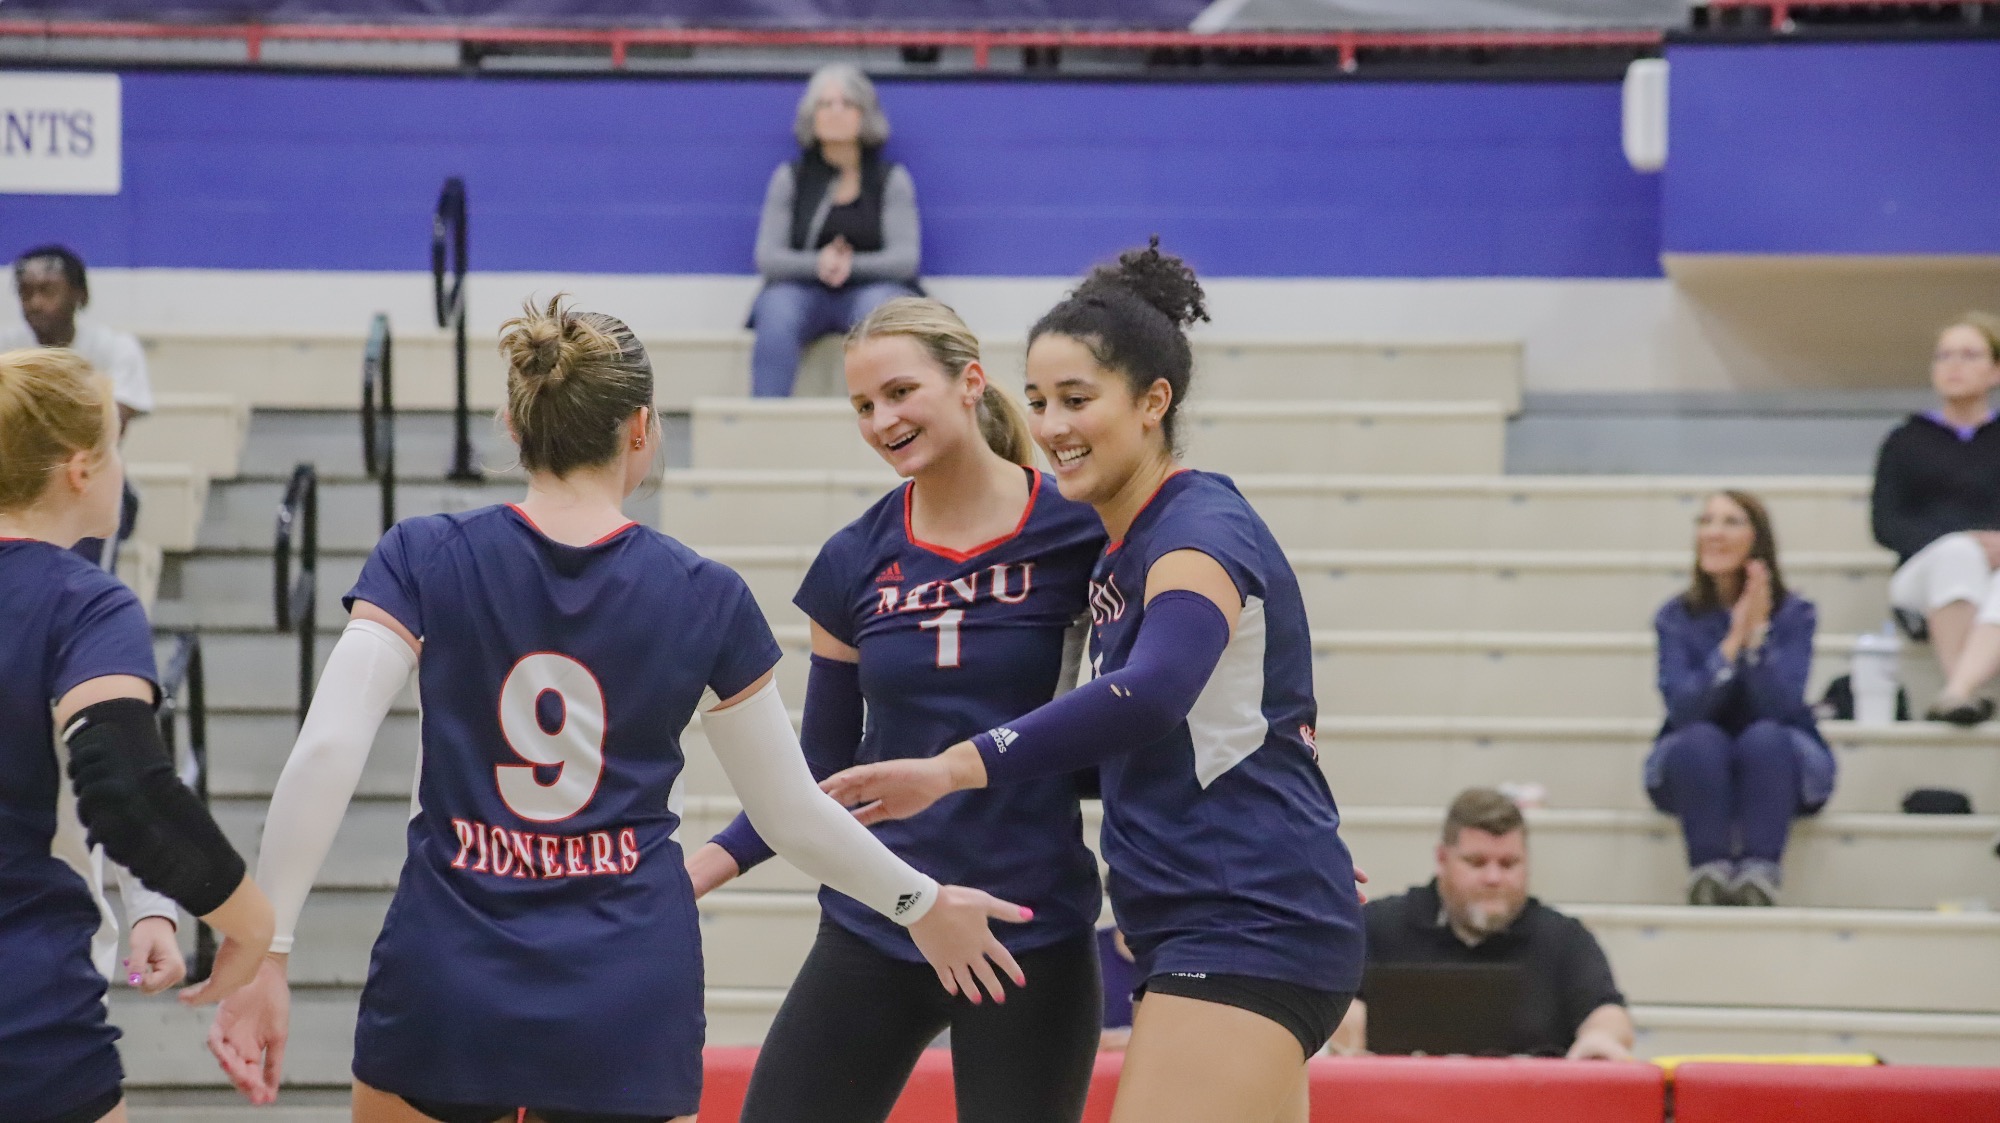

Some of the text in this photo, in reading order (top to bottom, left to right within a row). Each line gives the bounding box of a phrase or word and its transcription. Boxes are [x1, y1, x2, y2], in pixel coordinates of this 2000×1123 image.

[0, 111, 95, 156] NTS
[875, 562, 1035, 614] MNU
[919, 609, 966, 668] 1
[494, 651, 607, 824] 9
[451, 817, 641, 879] PIONEERS
